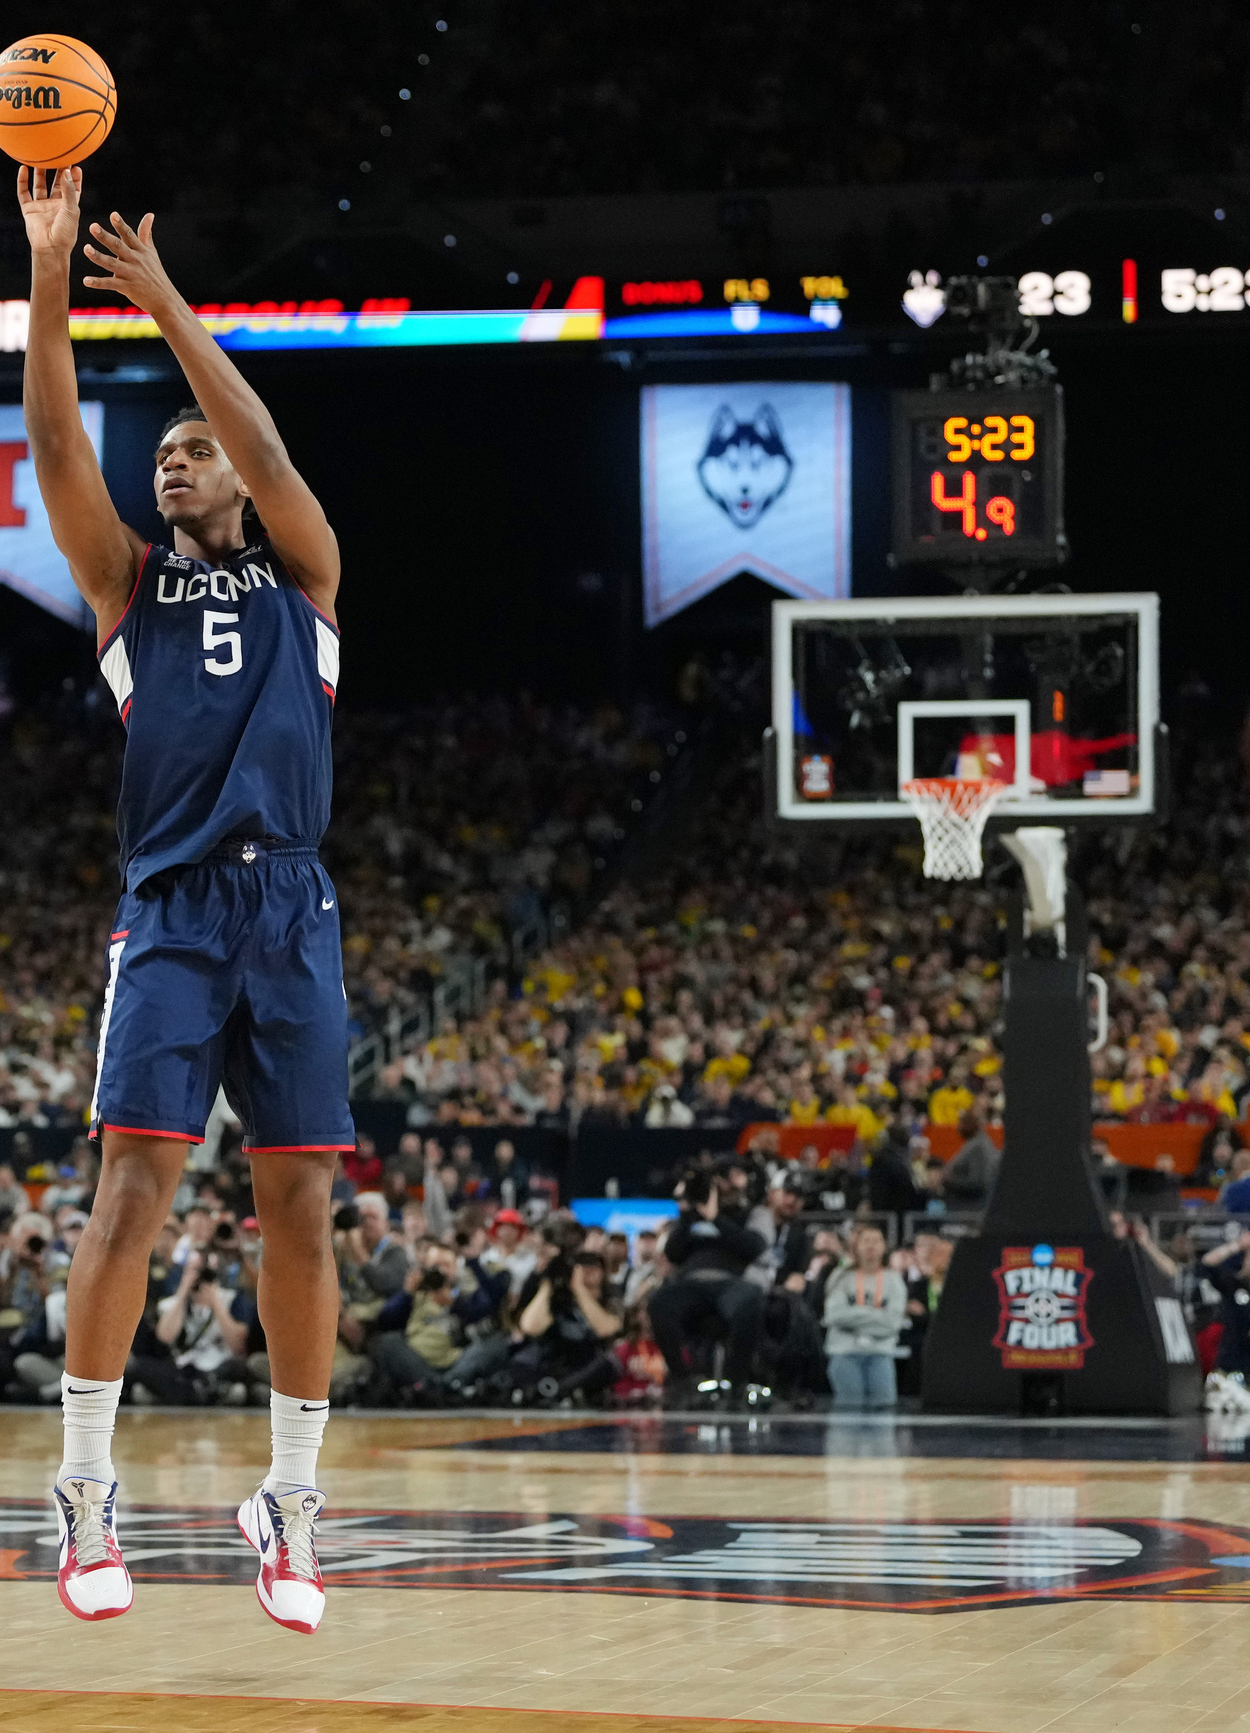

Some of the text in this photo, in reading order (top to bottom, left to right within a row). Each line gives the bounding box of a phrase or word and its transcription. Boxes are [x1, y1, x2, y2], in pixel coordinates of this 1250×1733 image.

[1161, 266, 1250, 313] 5:2
[943, 415, 1036, 463] 5:23
[930, 470, 1016, 541] 4.9
[156, 562, 278, 603] UCONN
[203, 609, 243, 676] 5
[1003, 1266, 1080, 1296] FINAL
[1006, 1320, 1079, 1350] FOUR
